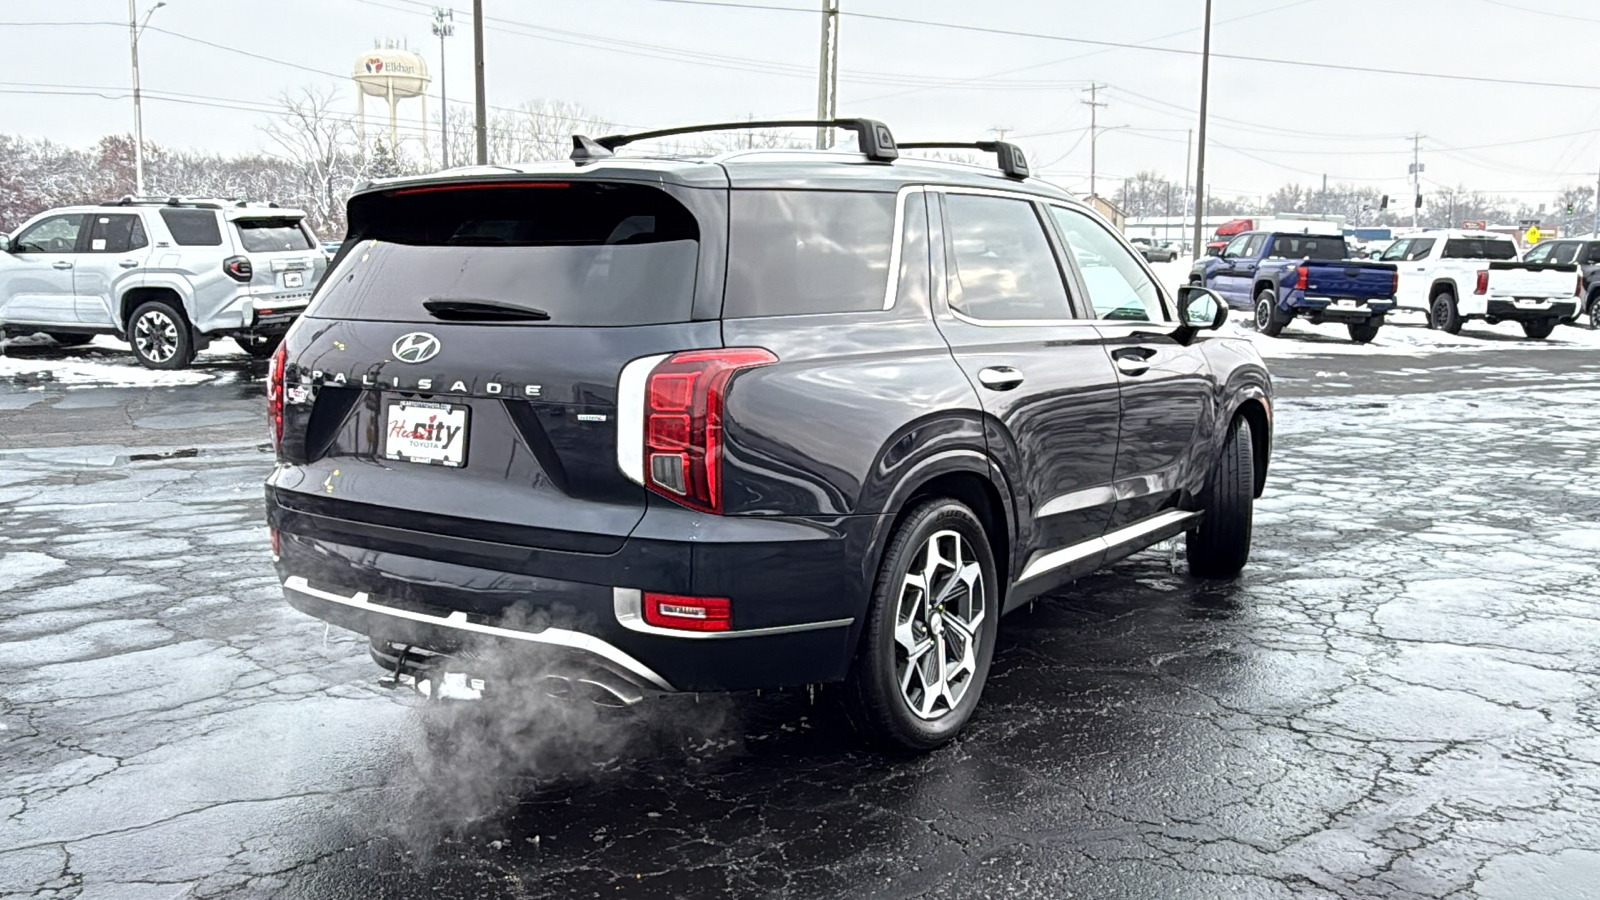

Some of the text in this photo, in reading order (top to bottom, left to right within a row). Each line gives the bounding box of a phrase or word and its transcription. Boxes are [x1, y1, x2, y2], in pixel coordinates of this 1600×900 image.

[385, 62, 414, 73] Elkhart
[312, 370, 543, 397] PALISADE
[389, 416, 462, 450] Heart city
[409, 440, 439, 449] TOYOTA
